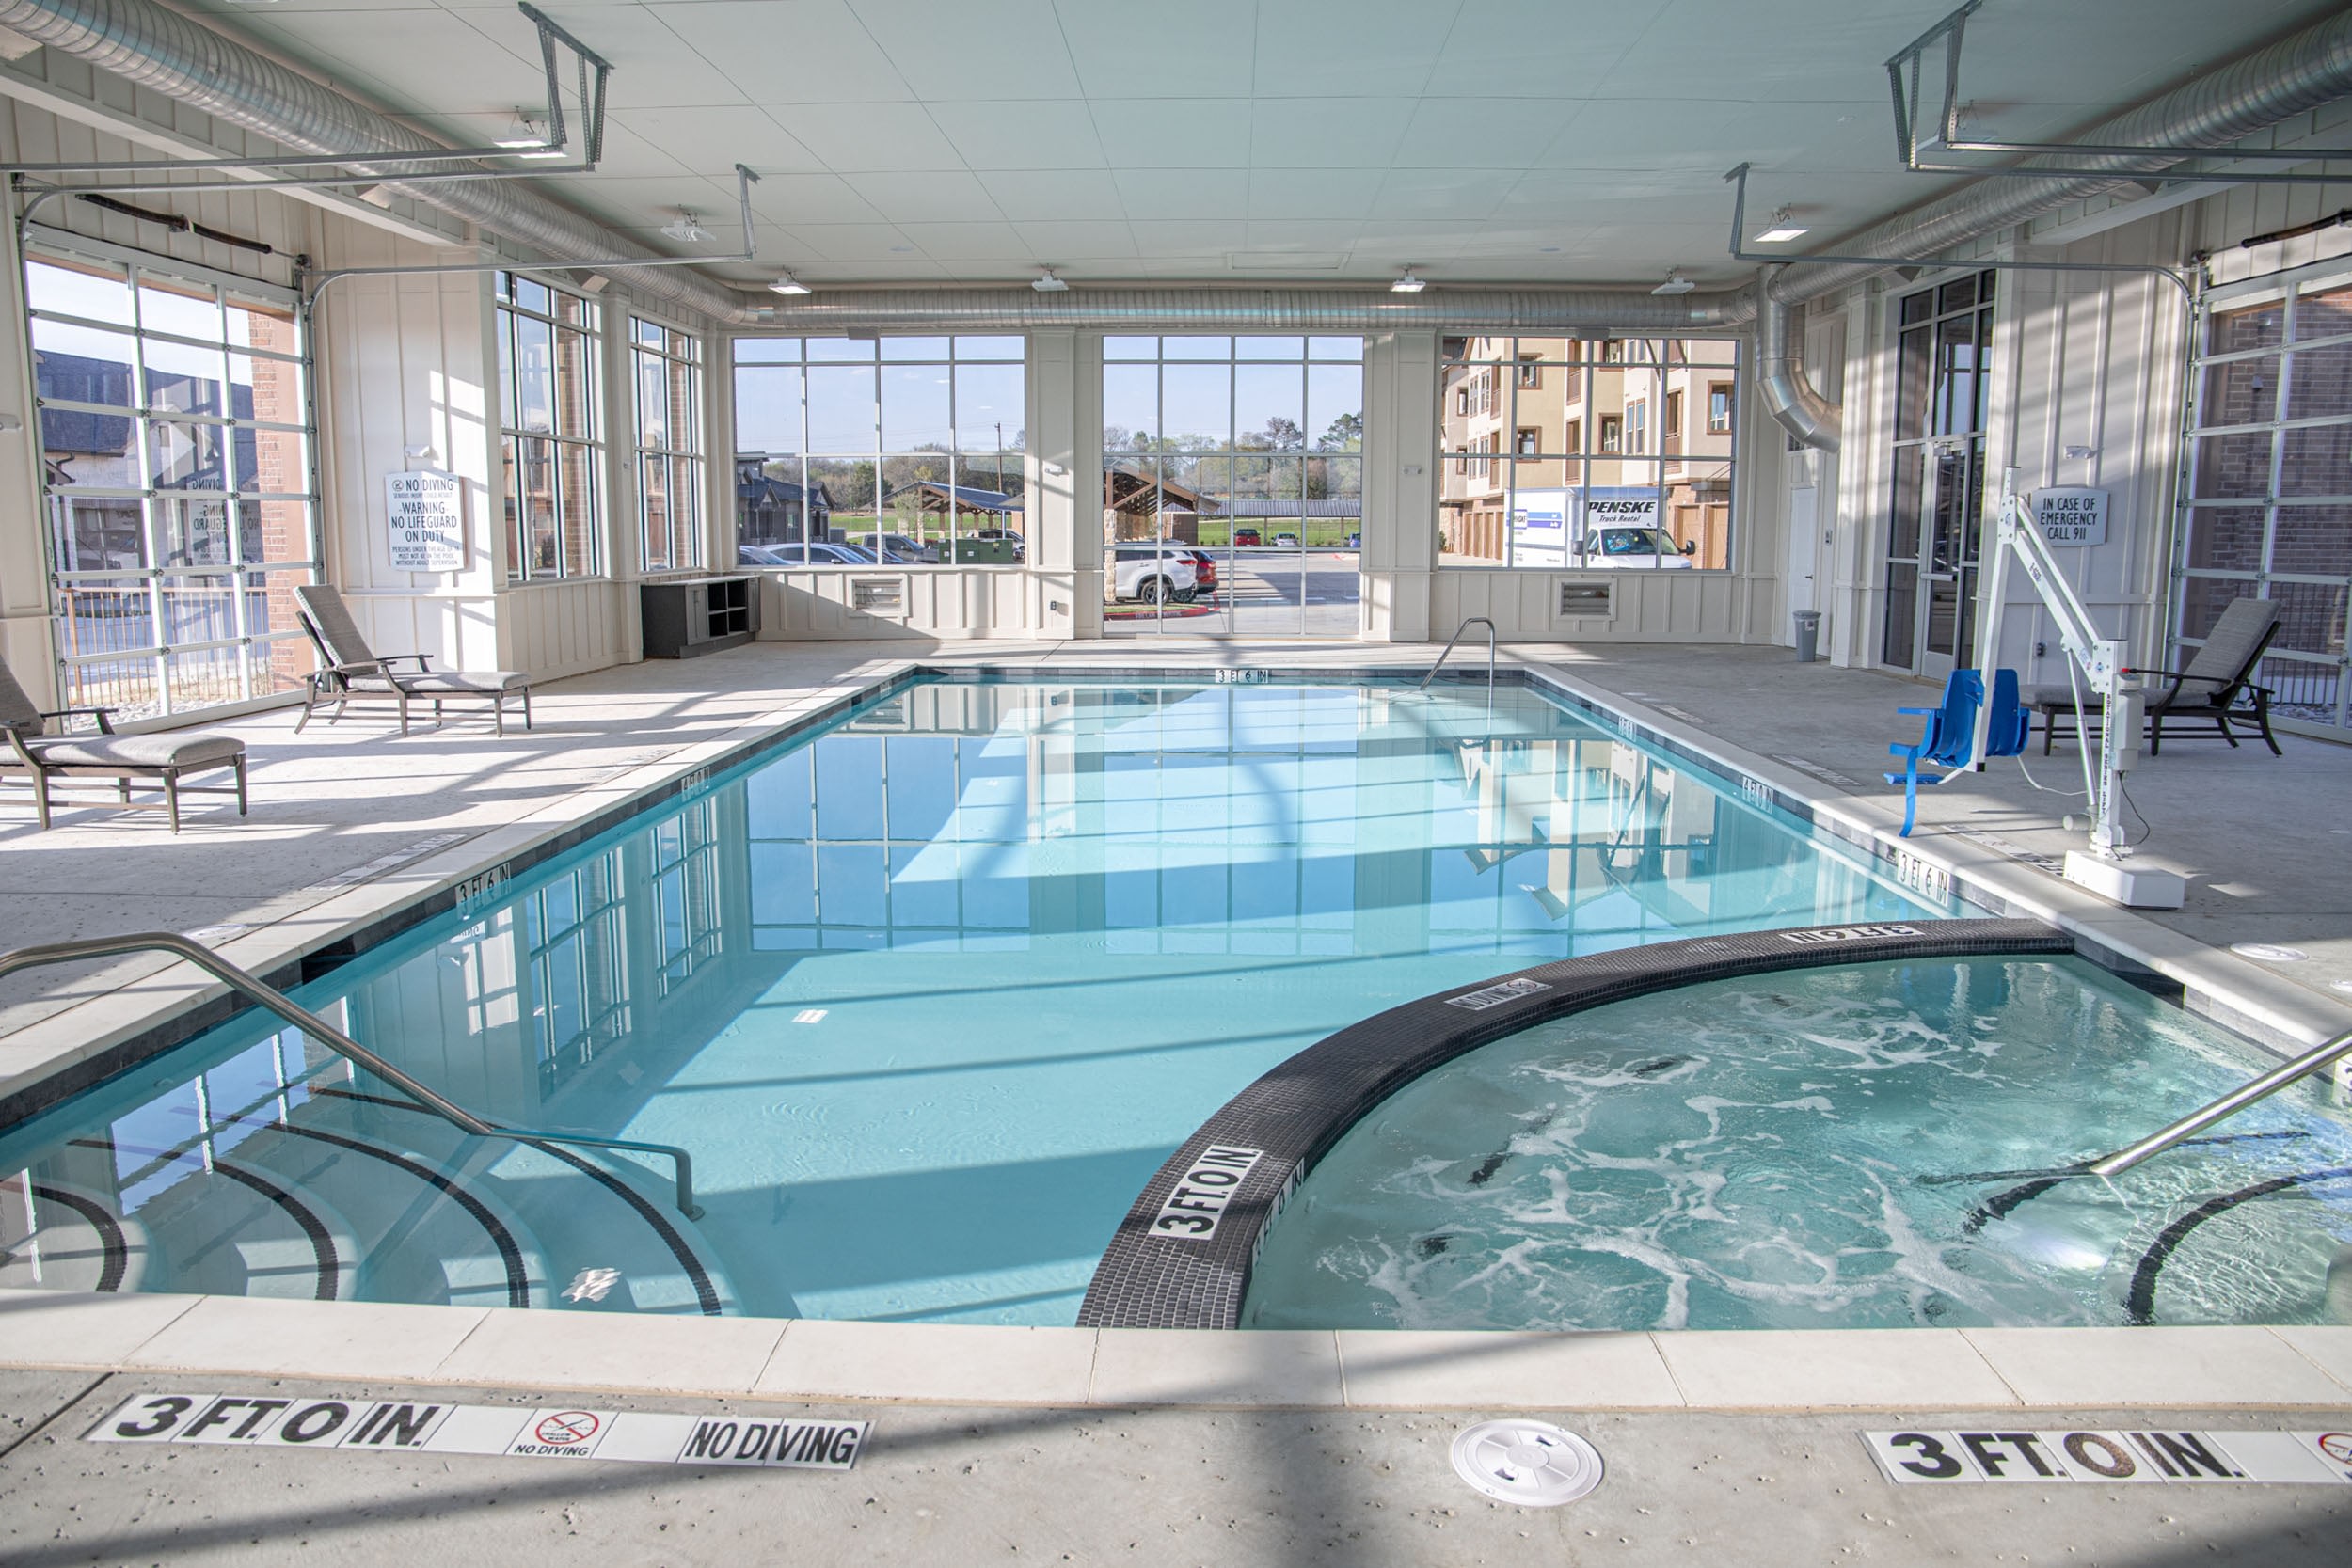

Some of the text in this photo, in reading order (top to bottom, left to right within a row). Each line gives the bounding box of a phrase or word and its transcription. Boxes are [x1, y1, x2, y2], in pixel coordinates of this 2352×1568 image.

[406, 479, 453, 491] NO DIVING
[1589, 501, 1656, 513] PENSKE
[2043, 498, 2095, 510] IN CASE OF
[391, 515, 457, 528] NO LIFEGUARD
[2040, 512, 2097, 525] EMERGENCY
[405, 530, 445, 542] ON DUTY
[2047, 527, 2086, 540] CALL 911
[1883, 926, 1914, 935] 3
[1157, 1214, 1214, 1234] 3
[116, 1396, 194, 1437] 3
[181, 1399, 292, 1440] FT.
[348, 1404, 440, 1447] IN.
[684, 1421, 859, 1465] NO DIVING
[514, 1444, 589, 1456] NO DIVING
[1890, 1433, 1963, 1478] 3
[1958, 1433, 2068, 1477] FT.
[2129, 1432, 2246, 1478] IN.
